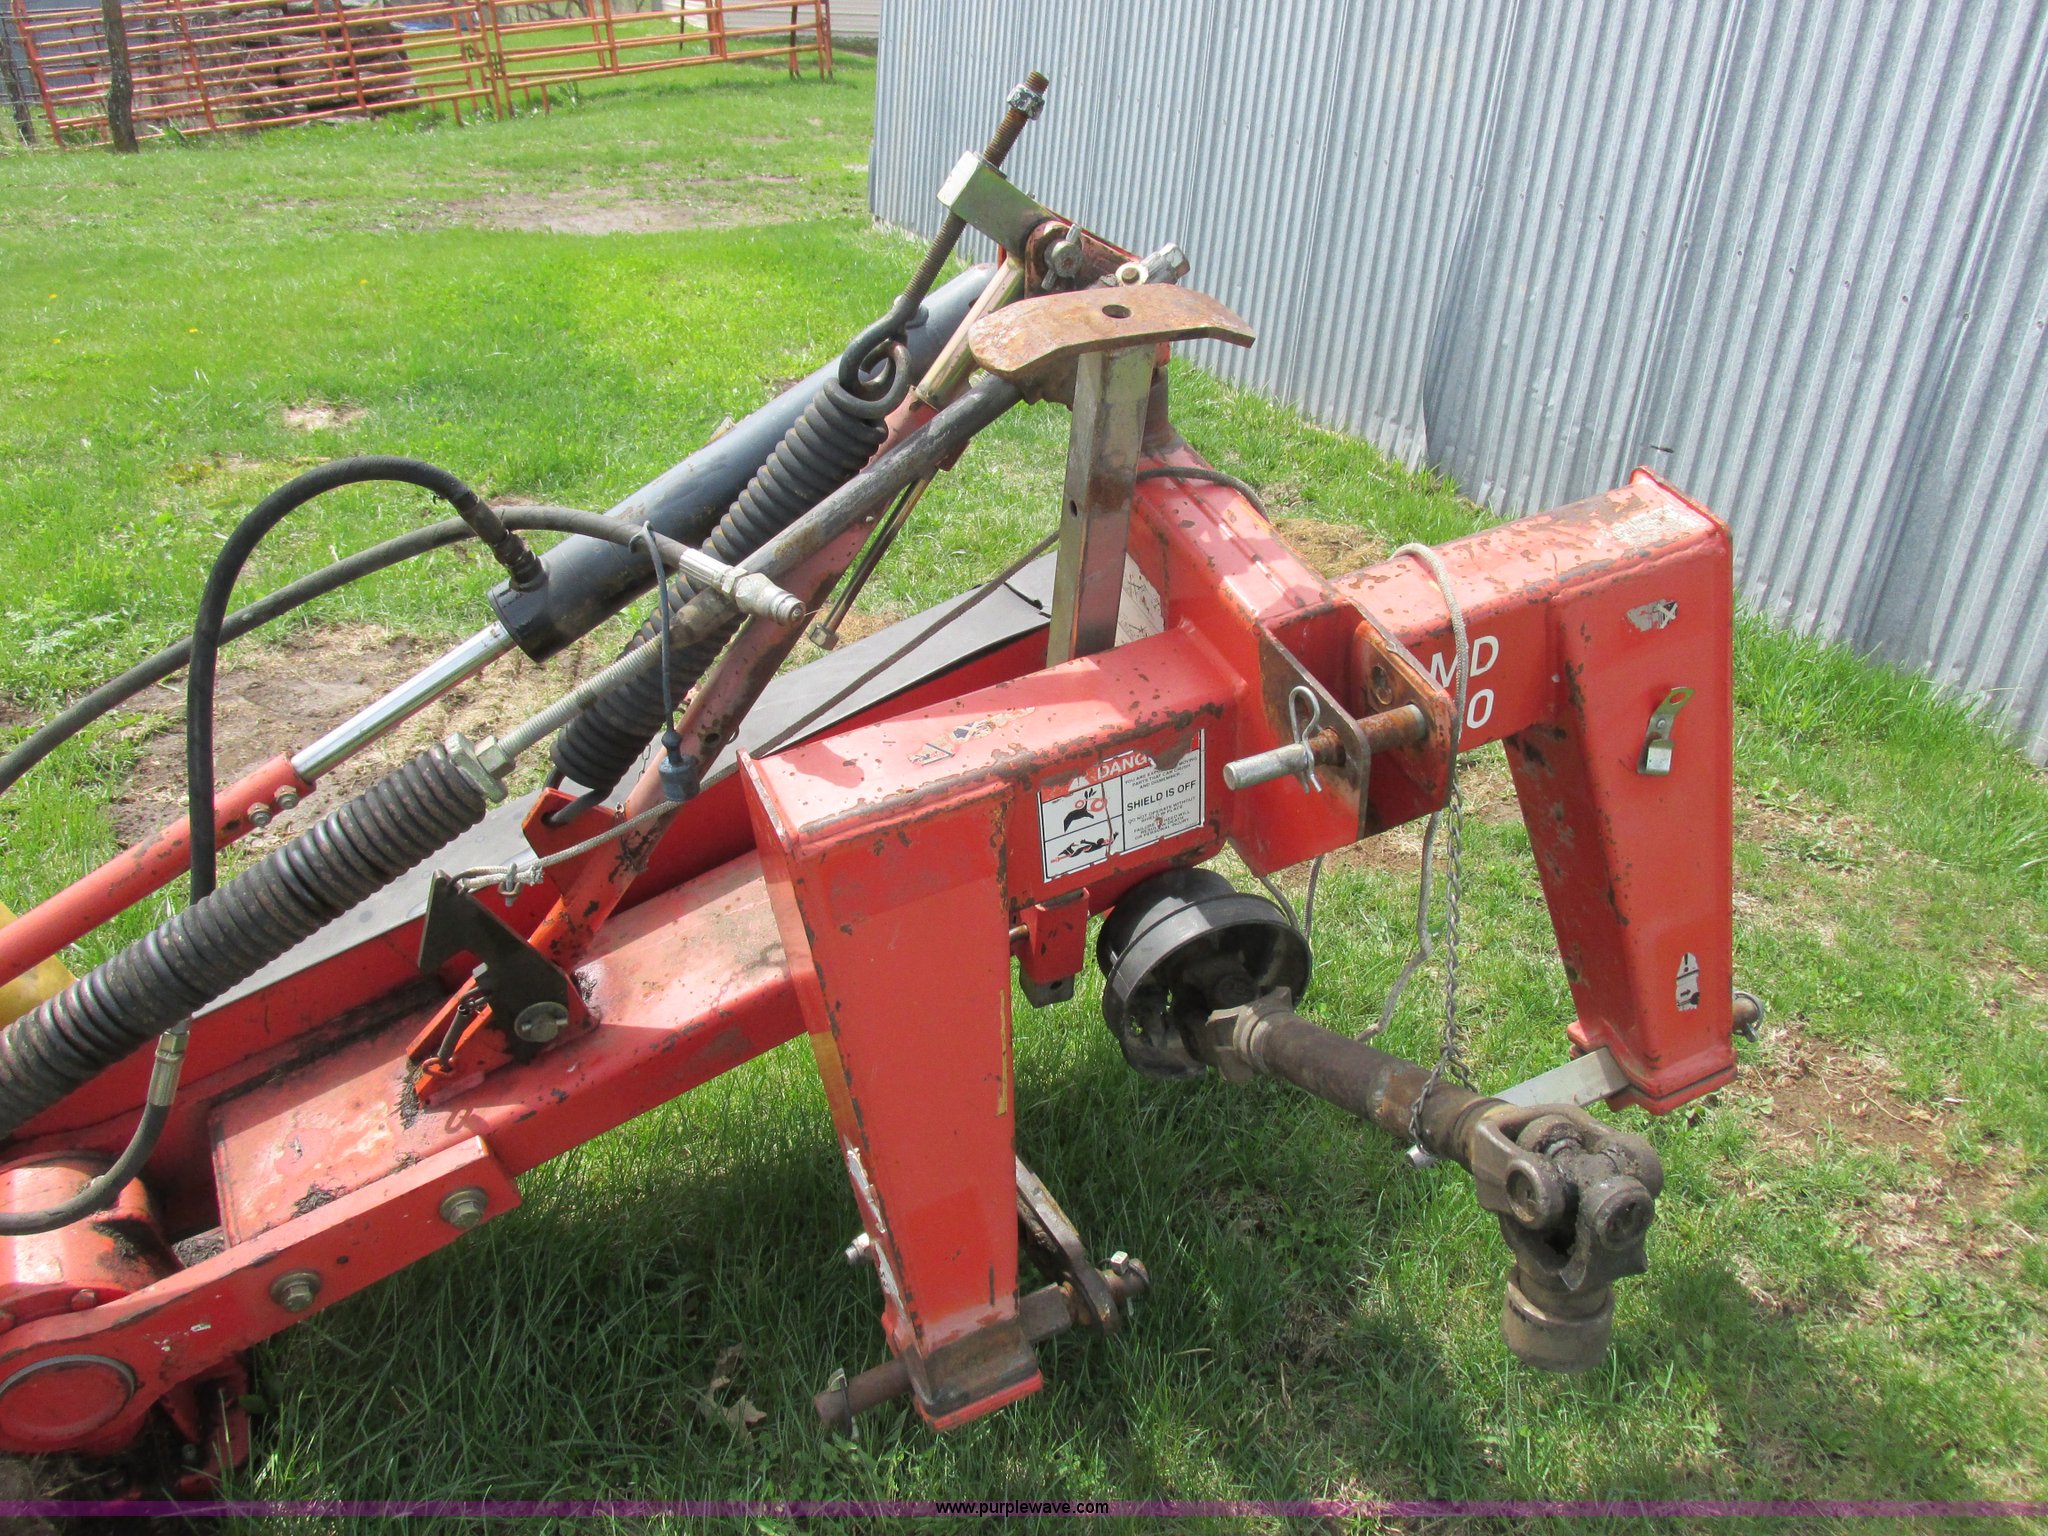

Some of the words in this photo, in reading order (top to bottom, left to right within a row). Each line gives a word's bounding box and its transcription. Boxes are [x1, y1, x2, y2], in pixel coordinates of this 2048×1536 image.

[1097, 752, 1148, 779] DANG
[1127, 791, 1162, 811] SHIELD
[1166, 787, 1174, 797] IS
[1177, 779, 1195, 793] OFF
